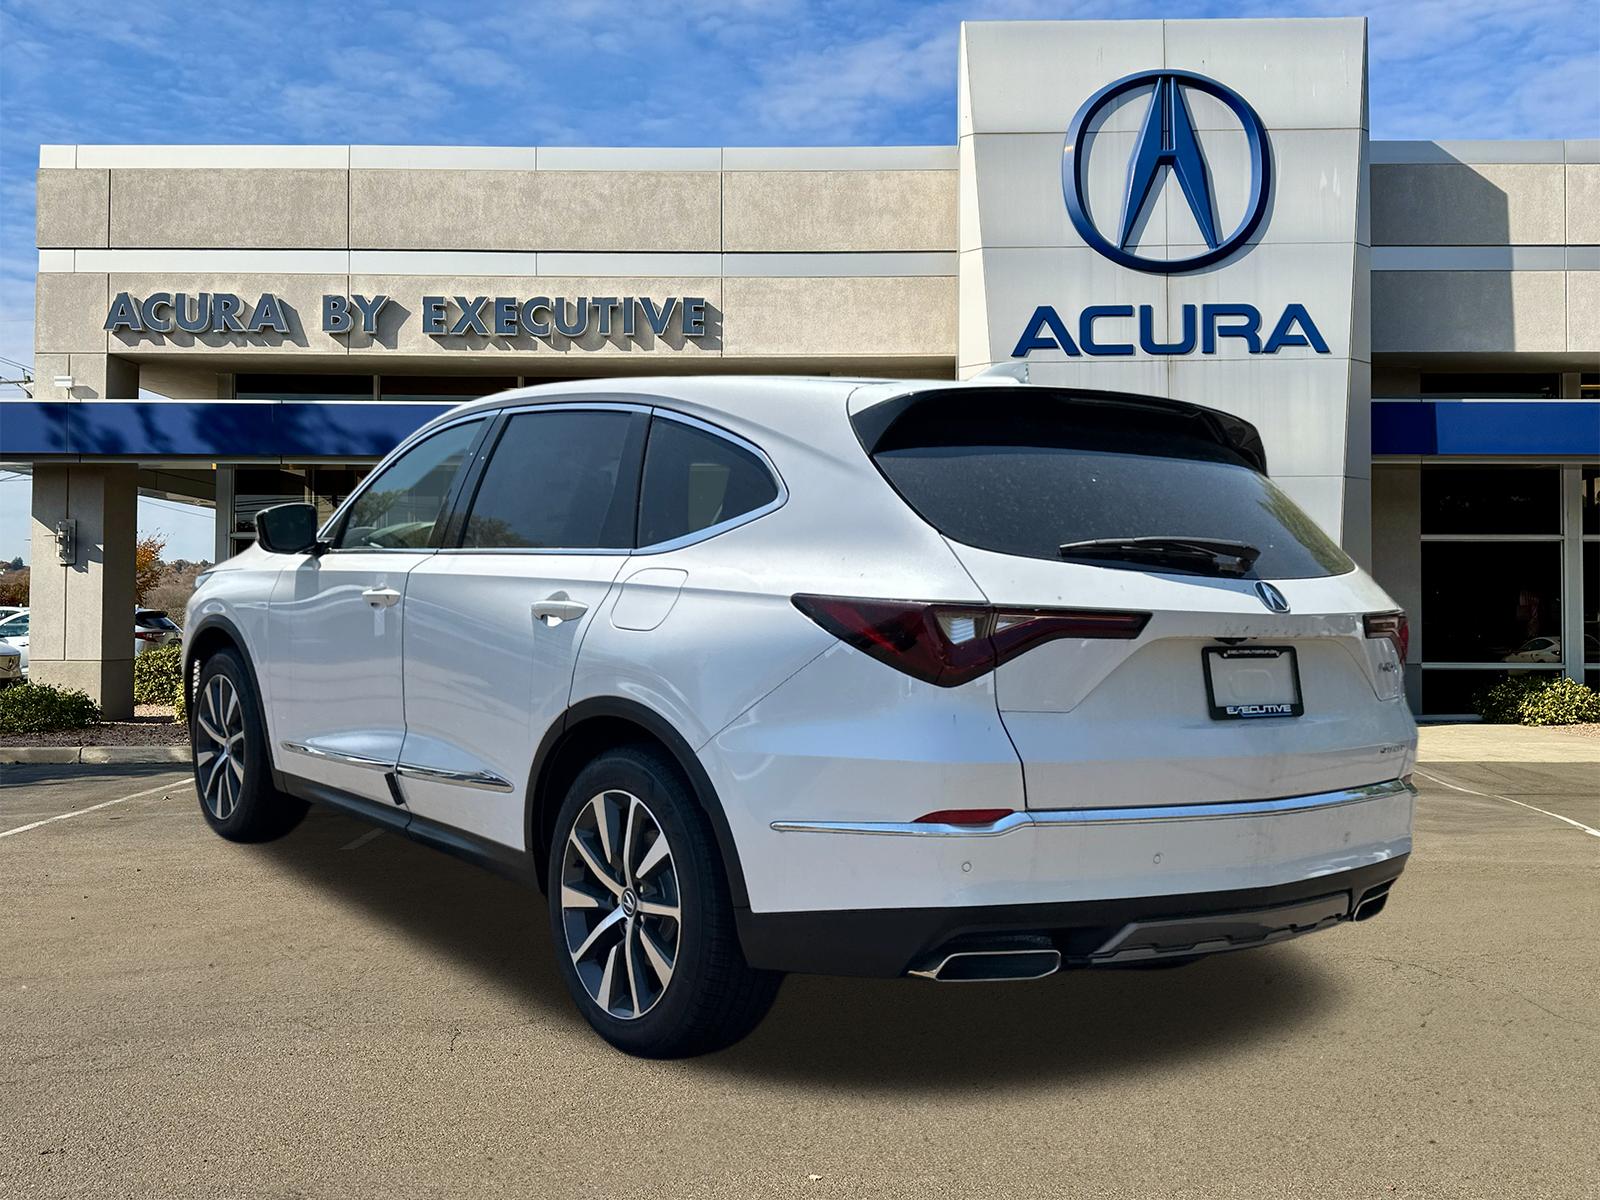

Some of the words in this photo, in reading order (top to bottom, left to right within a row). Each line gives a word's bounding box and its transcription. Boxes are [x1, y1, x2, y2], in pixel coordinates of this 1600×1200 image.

[103, 291, 290, 334] ACURA
[322, 294, 391, 334] BY
[422, 296, 706, 337] EXECUTIVE
[1010, 303, 1332, 357] ACURA
[1226, 704, 1292, 715] EXECUTIVE
